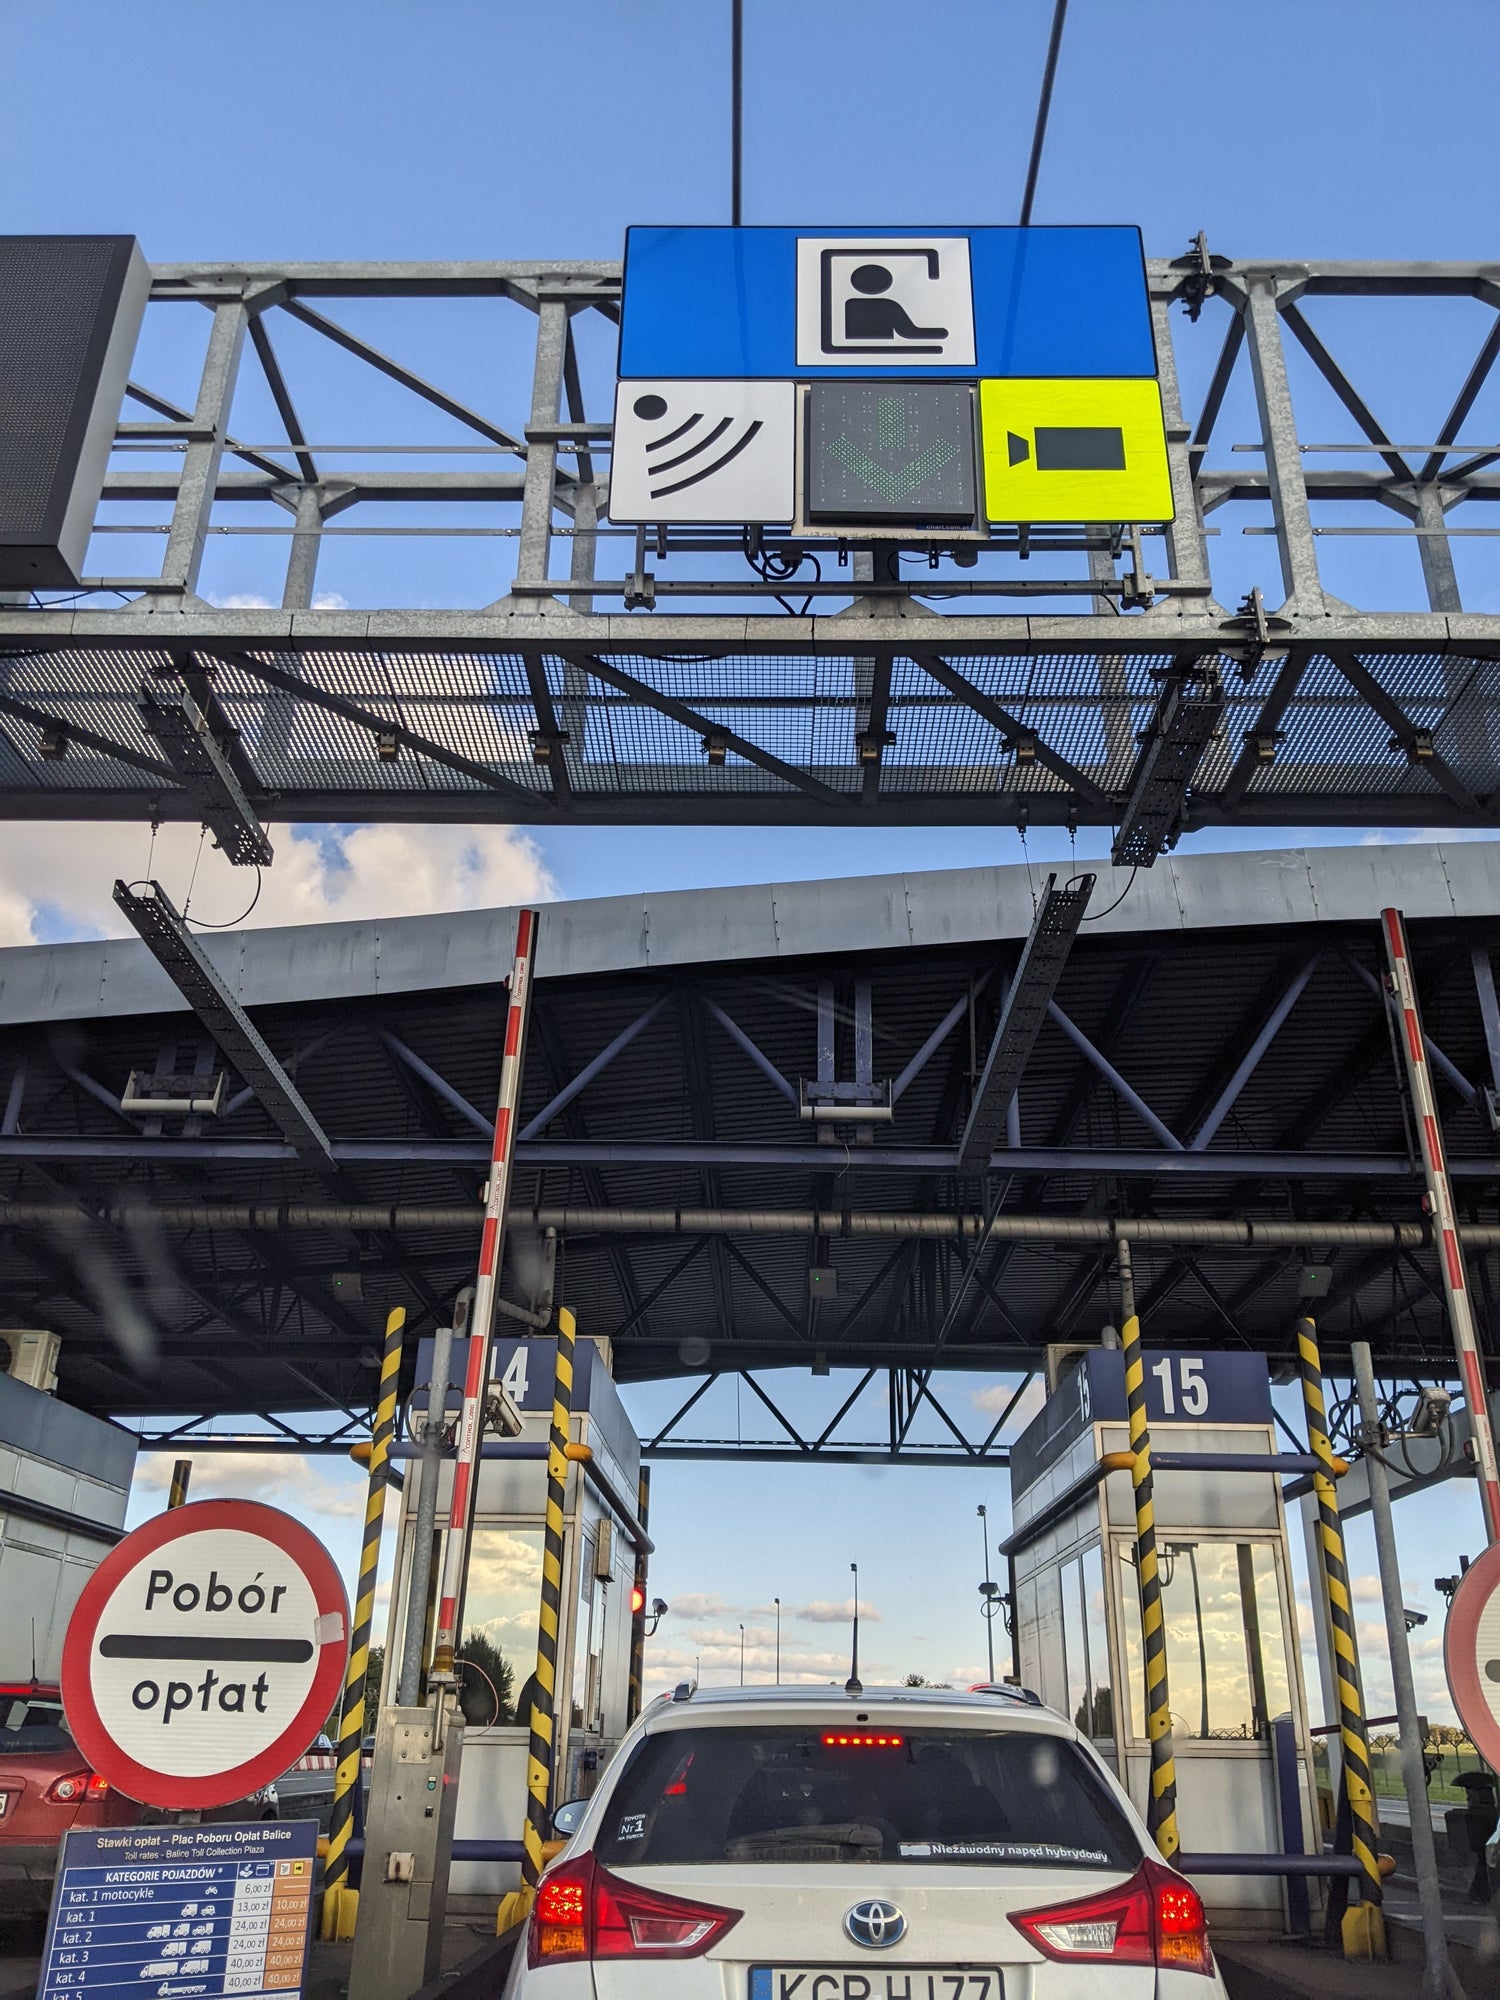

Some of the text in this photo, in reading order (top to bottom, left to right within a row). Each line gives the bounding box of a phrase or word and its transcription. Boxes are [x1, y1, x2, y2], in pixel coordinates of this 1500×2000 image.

[1077, 1360, 1090, 1422] 15
[1152, 1358, 1209, 1416] 15
[145, 1570, 287, 1614] Pobór
[132, 1669, 270, 1724] opłat
[96, 1837, 132, 1848] Stawki
[172, 1834, 194, 1845] Plac
[196, 1833, 232, 1844] Poboru
[262, 1830, 292, 1840] Balice
[124, 1852, 137, 1860] Toll
[140, 1852, 158, 1860] rates
[166, 1850, 190, 1858] Balice
[192, 1848, 204, 1857] Toll
[206, 1846, 242, 1856] Collection
[244, 1845, 264, 1854] Plaza
[932, 1844, 1108, 1862] Niezawodny napęd hybrydowy
[106, 1868, 216, 1883] KATEGORIE POJAZDÓW
[244, 1882, 271, 1894] 6,00 zł
[70, 1888, 154, 1903] kat. 1 motocykle
[238, 1900, 269, 1912] 13,00 zł
[276, 1898, 307, 1910] 10,00 zł
[66, 1910, 95, 1923] kat. 1
[274, 1916, 306, 1928] 24,00 zł
[235, 1919, 267, 1931] 24,00 zł
[62, 1932, 92, 1944] kat. 2
[233, 1938, 265, 1950] 24,00 zł
[272, 1935, 304, 1947] 24,00 zł
[60, 1951, 89, 1964] kat. 3
[230, 1956, 263, 1969] 40,00 zł
[270, 1953, 302, 1966] 40,00 zł
[56, 1970, 86, 1984] kat. 4
[228, 1975, 260, 1988] 40,00 zł
[268, 1972, 300, 1984] 40,00 zł
